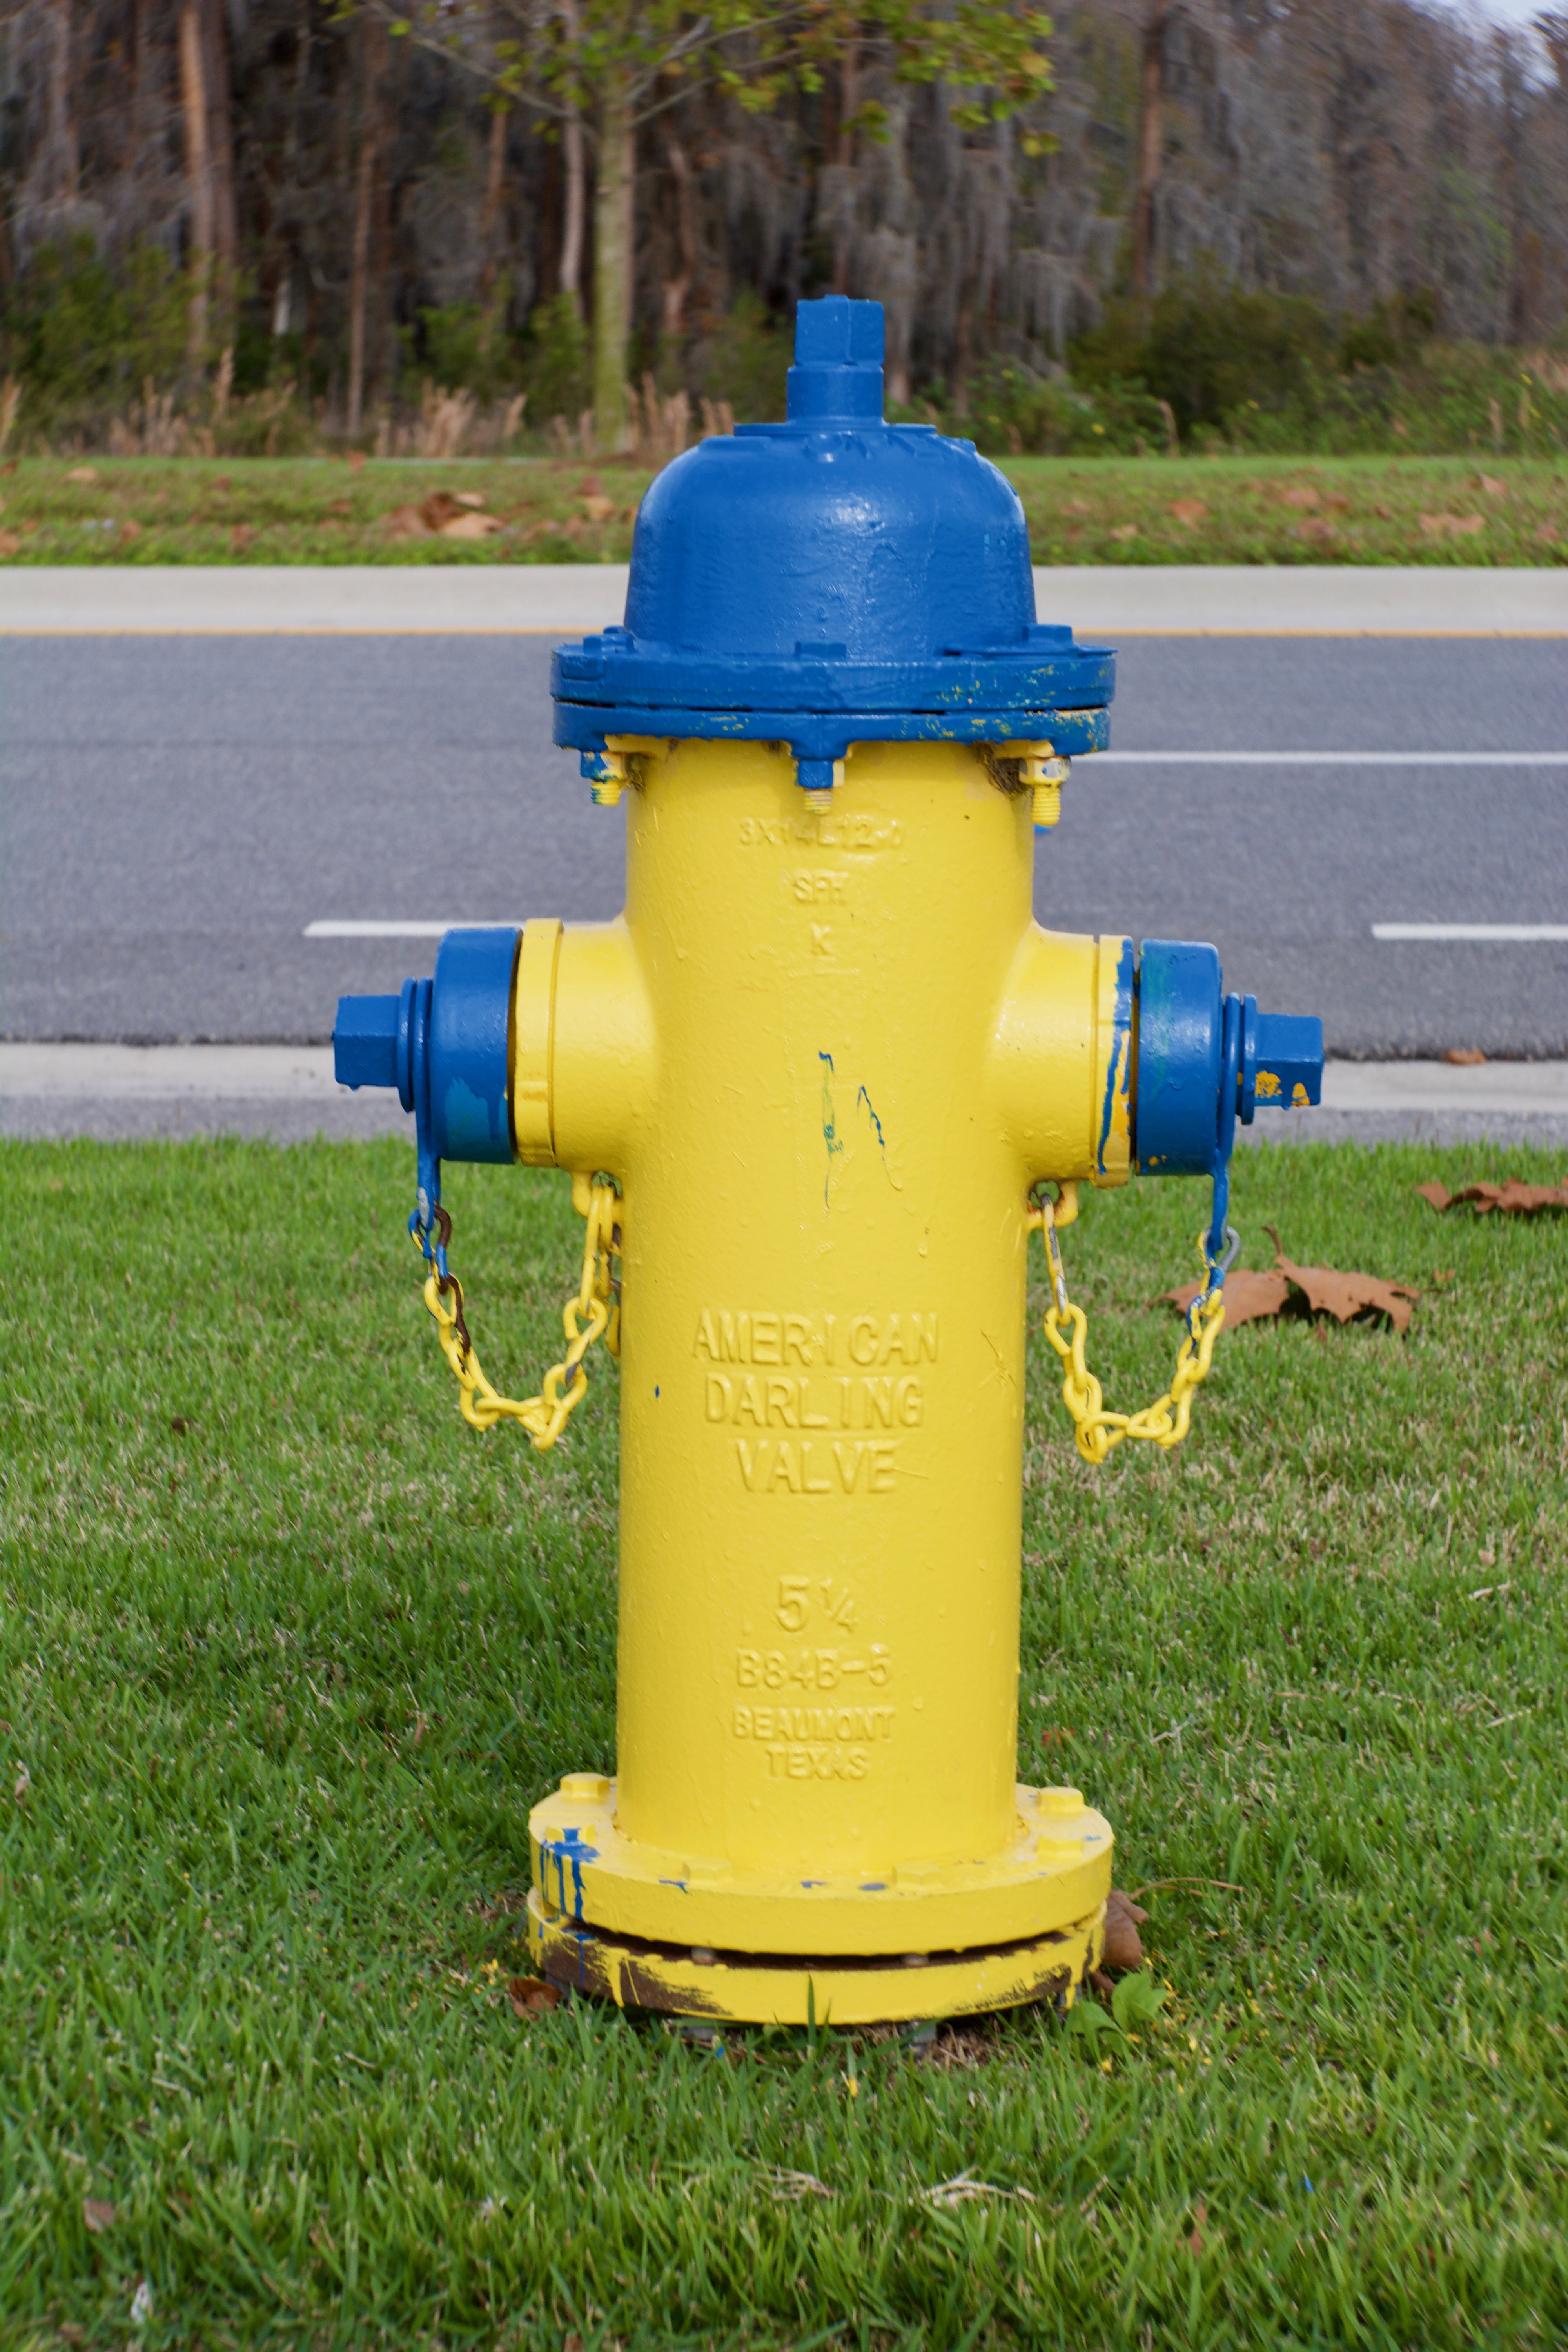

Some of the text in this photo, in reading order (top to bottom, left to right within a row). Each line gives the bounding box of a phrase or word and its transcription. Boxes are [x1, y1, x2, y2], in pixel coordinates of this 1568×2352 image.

[693, 1309, 938, 1366] AMERICAN
[706, 1373, 924, 1428] DARLING
[736, 1439, 900, 1494] VALVE
[733, 1704, 895, 1742] BEAUMONT
[766, 1743, 869, 1780] TEXAS
